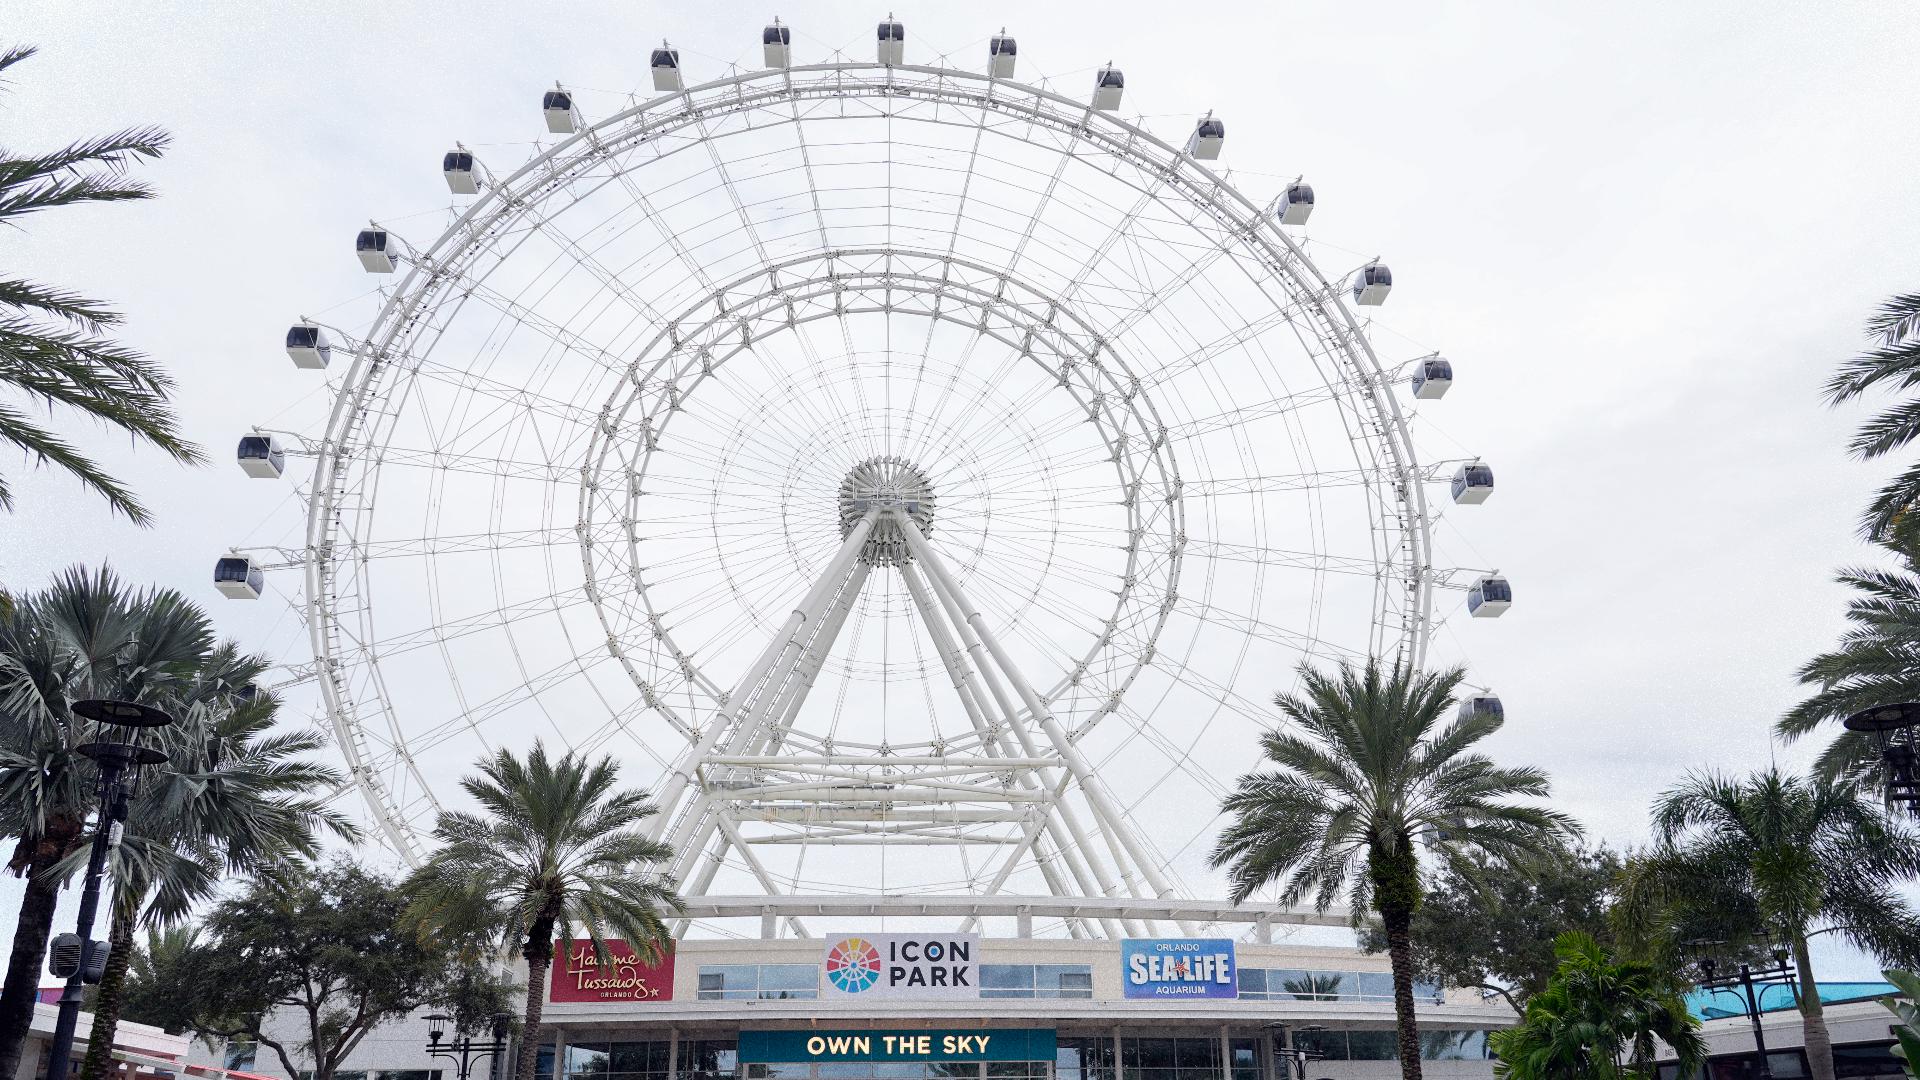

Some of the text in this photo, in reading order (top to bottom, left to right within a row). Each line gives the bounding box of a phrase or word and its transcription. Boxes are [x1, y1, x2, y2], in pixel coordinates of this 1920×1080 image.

[569, 944, 640, 969] Mame
[890, 941, 970, 962] ICON
[1156, 943, 1200, 952] ORLANDO
[568, 966, 648, 998] Tussauds
[890, 966, 970, 987] PARK
[1156, 986, 1206, 995] AQUARIUM
[807, 1035, 991, 1056] OWN THE SKY
